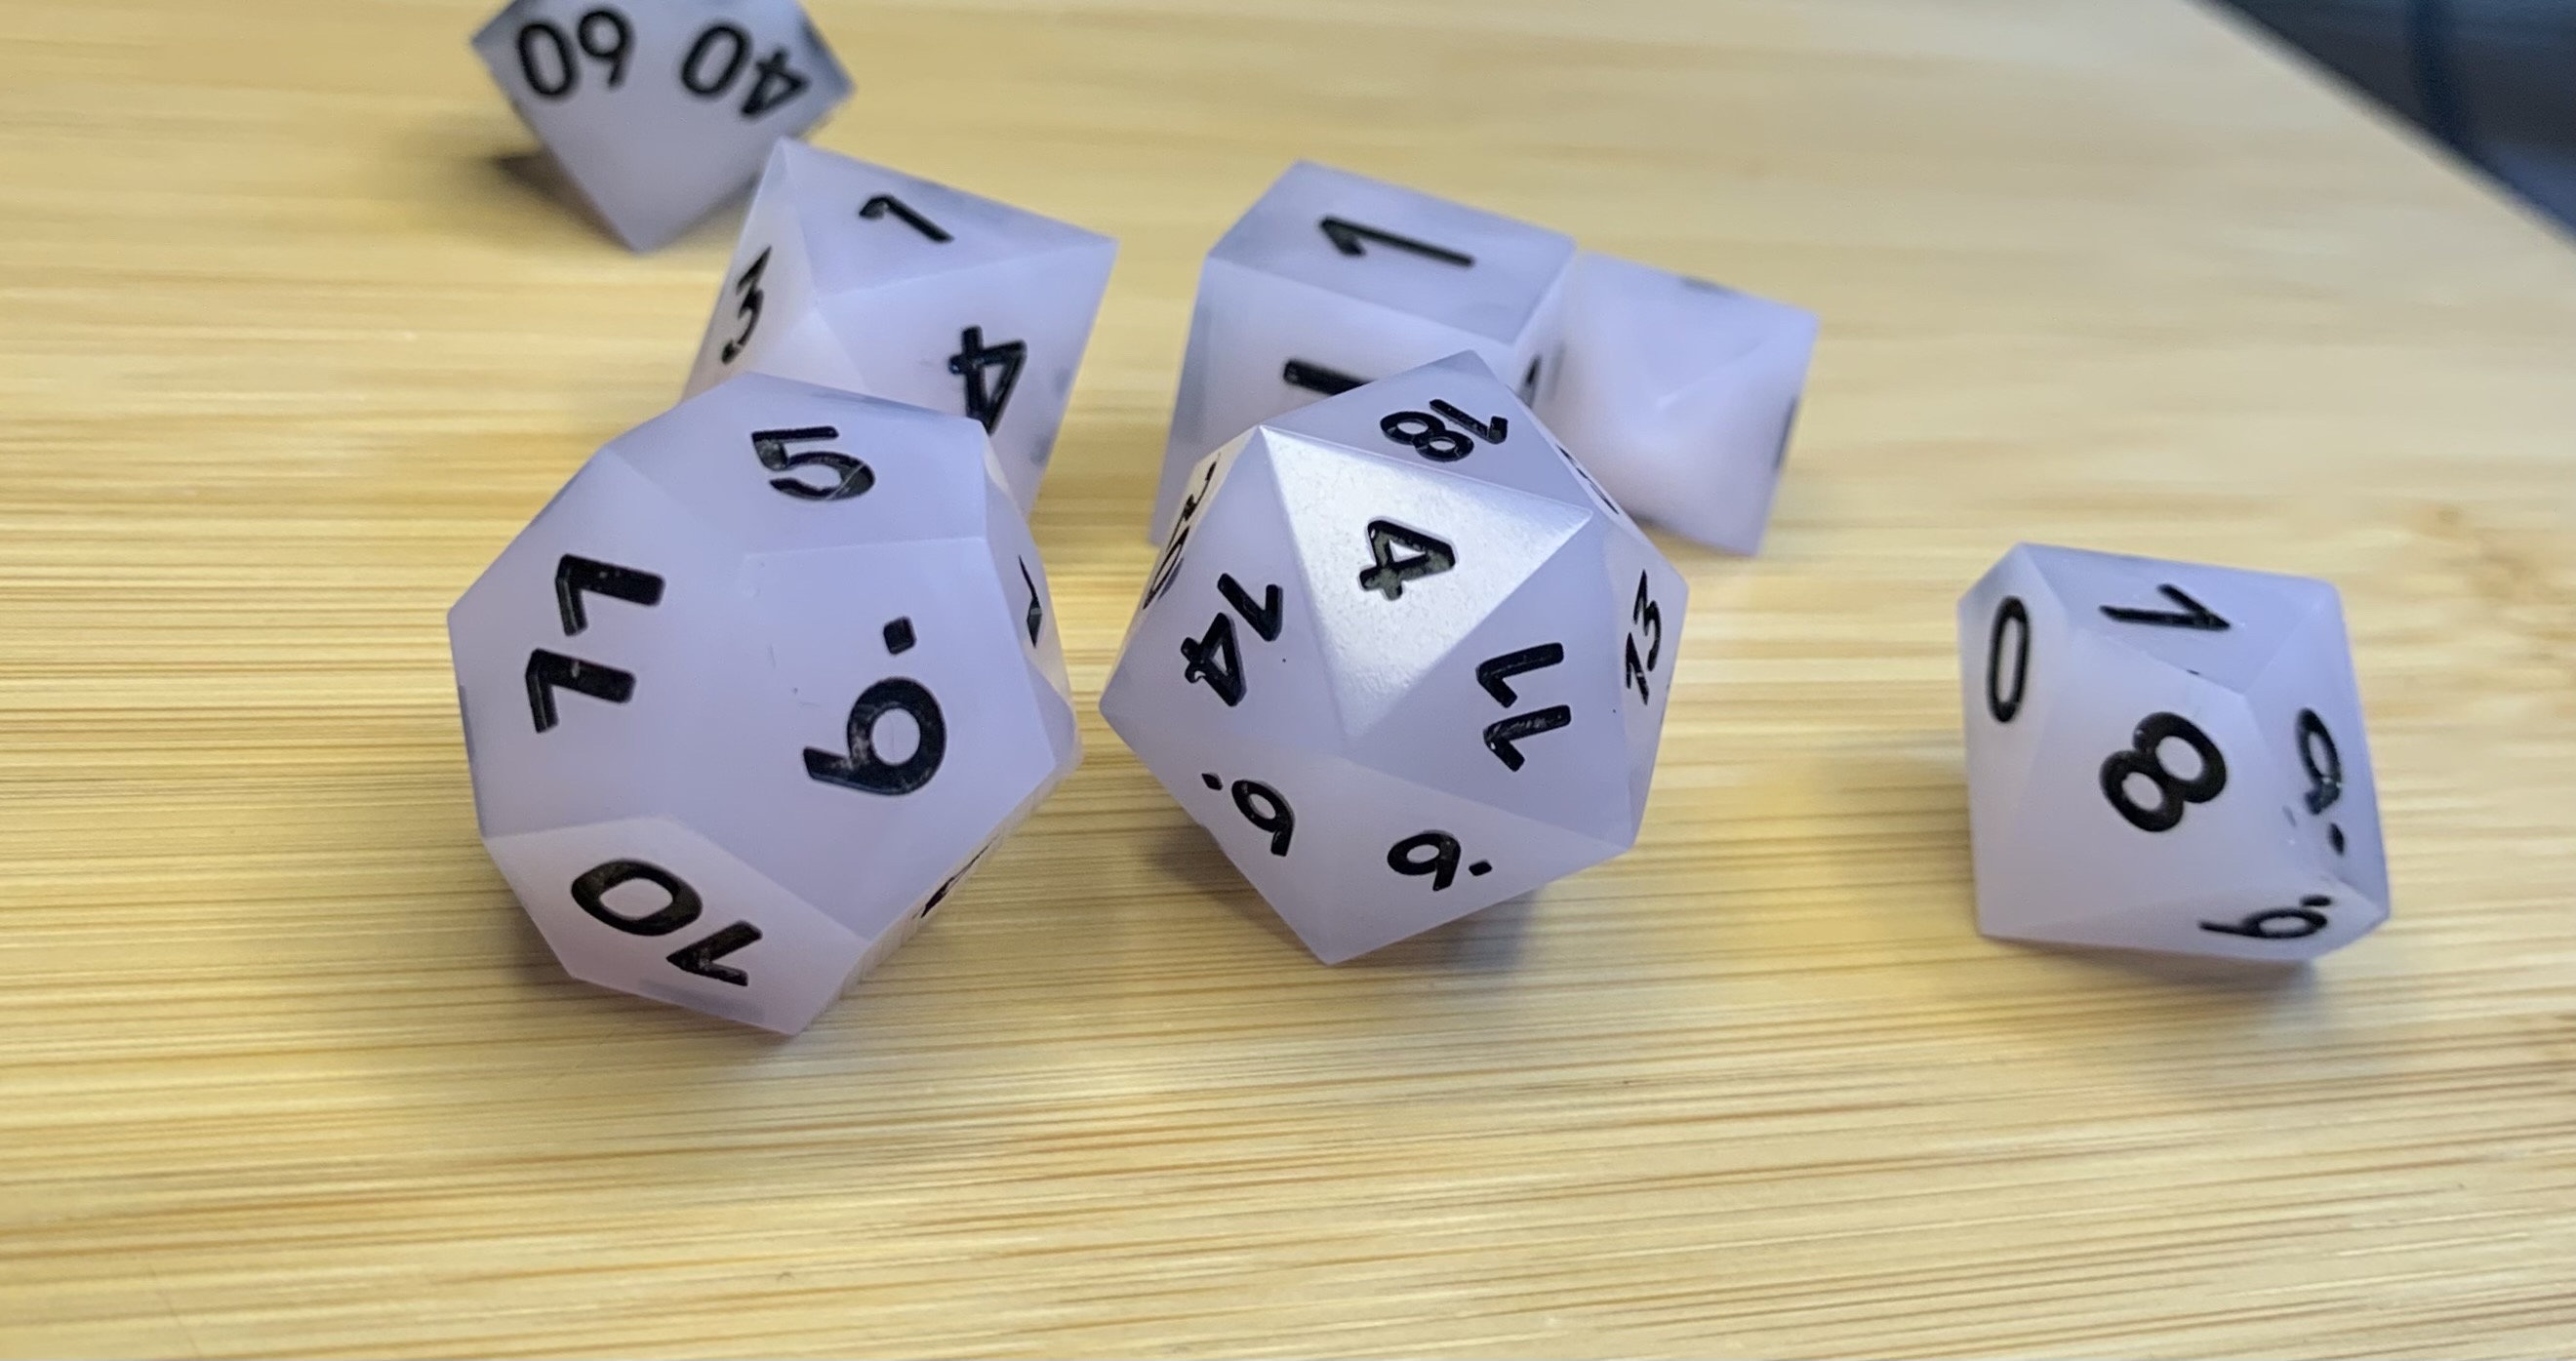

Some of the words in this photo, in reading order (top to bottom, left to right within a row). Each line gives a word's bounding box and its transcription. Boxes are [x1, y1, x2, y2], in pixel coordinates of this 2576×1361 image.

[680, 22, 809, 118] 40
[1317, 215, 1475, 268] 1
[719, 246, 772, 366] 3
[946, 325, 1027, 435] 4
[1378, 397, 1509, 464] 18
[749, 424, 876, 502] 5
[1357, 518, 1457, 602] 4
[2099, 582, 2232, 633] 1
[523, 552, 666, 736] 11
[1179, 572, 1284, 708] 14
[1624, 568, 1663, 706] 13
[1986, 595, 2032, 725] 0
[1473, 641, 1573, 774] 11
[2098, 710, 2229, 834] 8
[570, 858, 764, 988] 10
